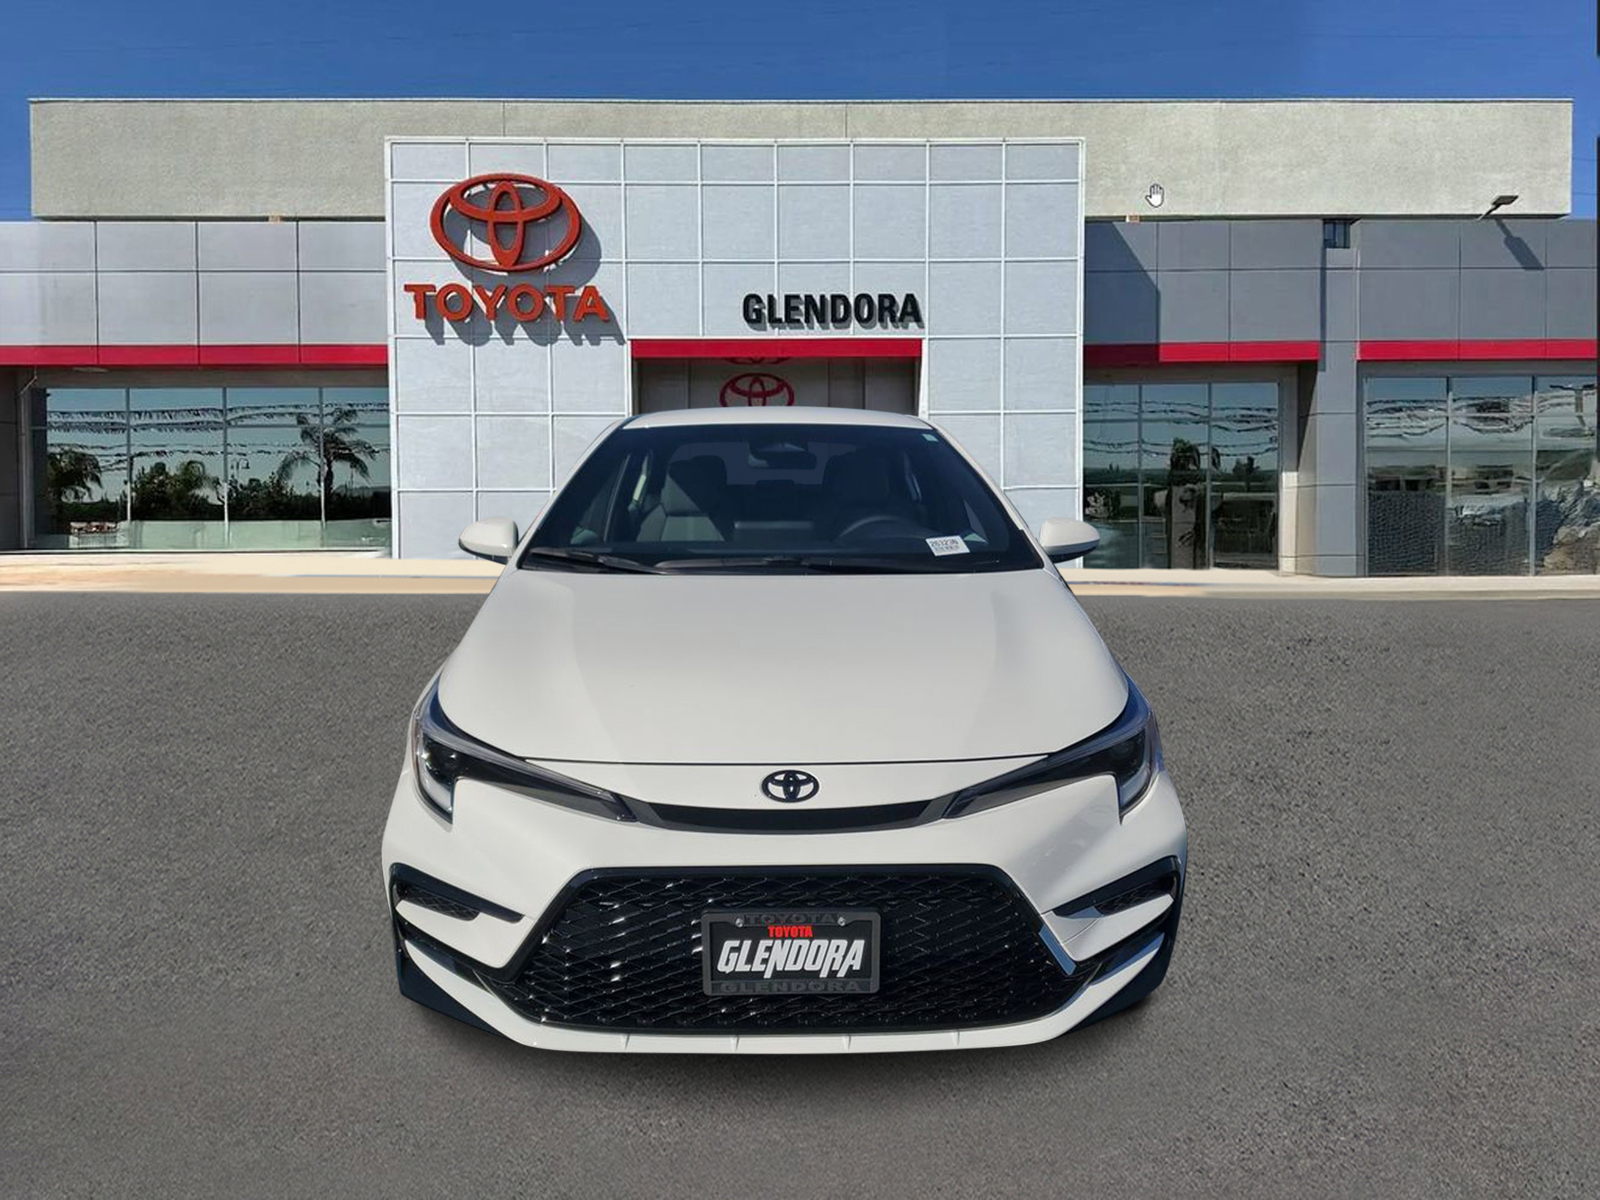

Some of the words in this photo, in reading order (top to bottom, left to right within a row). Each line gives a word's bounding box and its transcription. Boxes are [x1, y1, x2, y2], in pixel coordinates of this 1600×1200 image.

[404, 284, 609, 322] TOYOTA
[743, 293, 922, 324] GLENDORA
[746, 913, 836, 924] TOYOTA
[767, 925, 813, 938] TOYOTA
[717, 939, 865, 978] GLENDORA
[719, 981, 861, 992] GLENDORA
